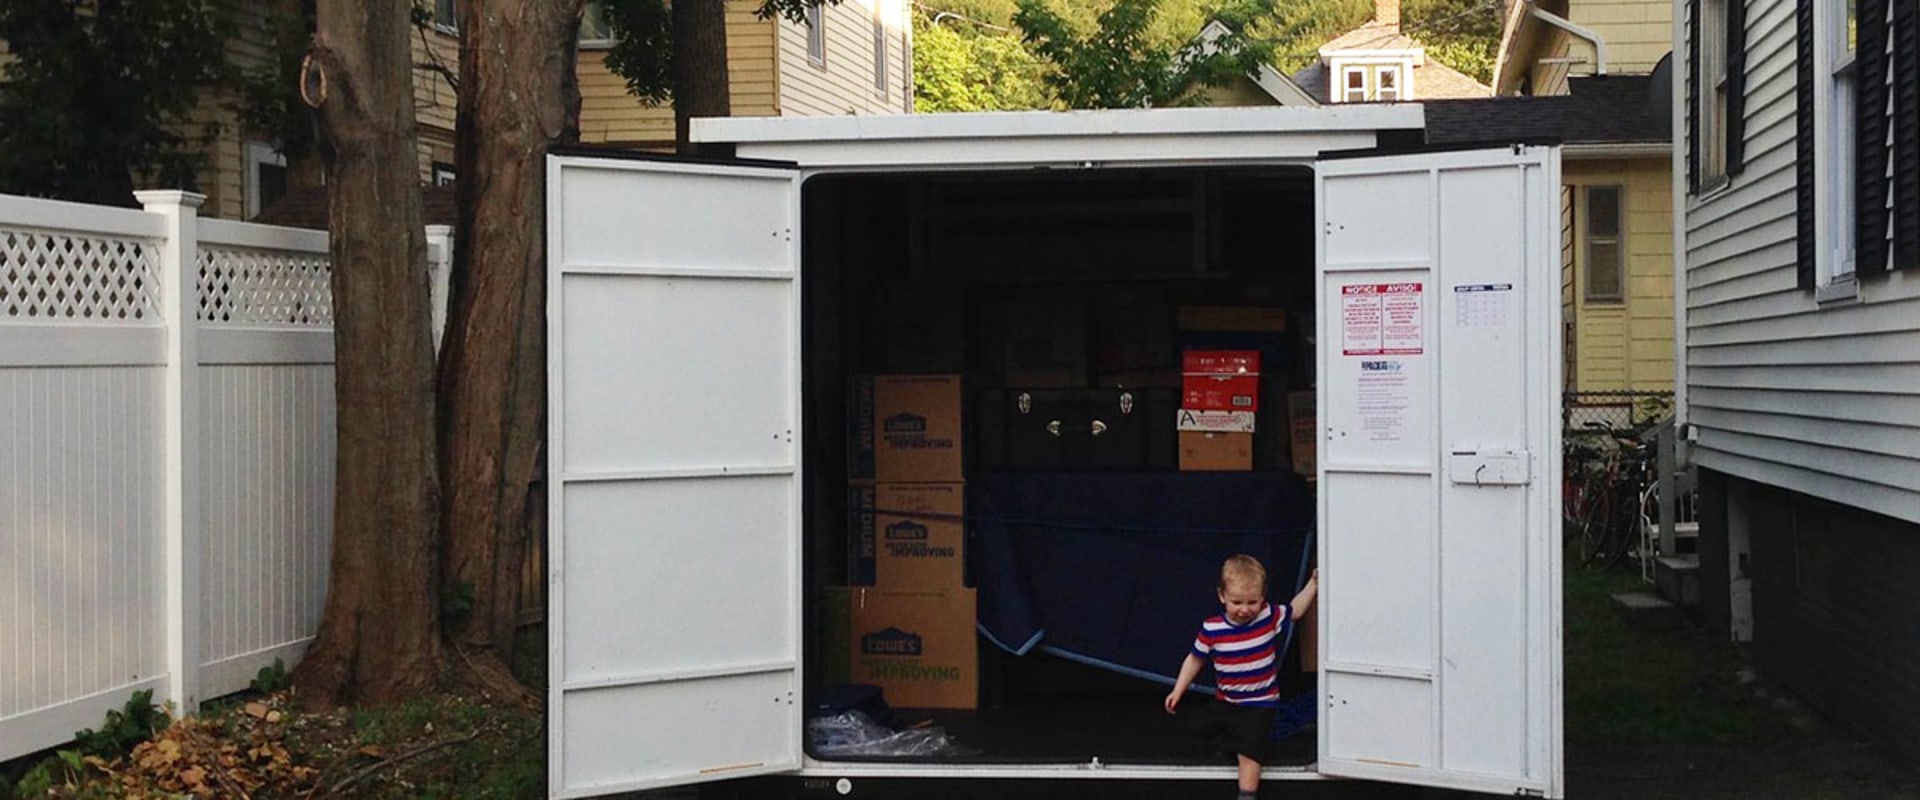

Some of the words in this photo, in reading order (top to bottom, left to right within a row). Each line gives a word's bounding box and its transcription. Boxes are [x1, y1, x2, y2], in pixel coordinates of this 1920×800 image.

[1180, 410, 1196, 426] A
[890, 438, 953, 449] IMPROVING
[861, 488, 874, 559] MEDIUM
[890, 546, 953, 557] IMPROVING
[867, 636, 917, 653] LOWE'S
[870, 666, 960, 680] IMPROVING
